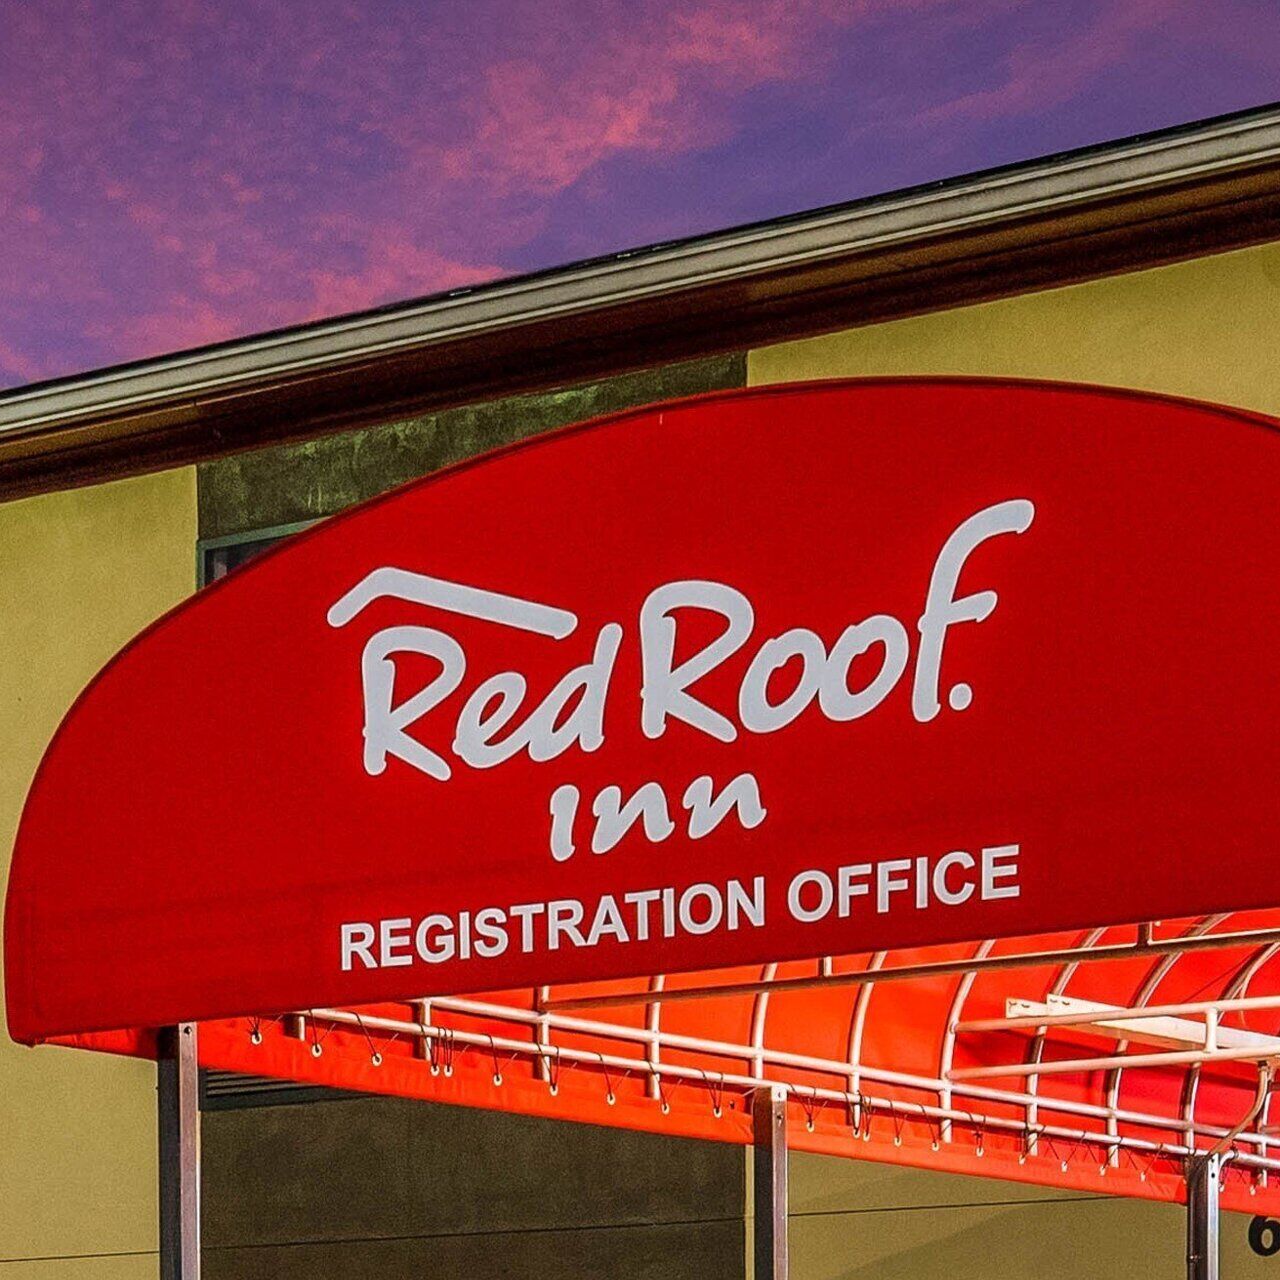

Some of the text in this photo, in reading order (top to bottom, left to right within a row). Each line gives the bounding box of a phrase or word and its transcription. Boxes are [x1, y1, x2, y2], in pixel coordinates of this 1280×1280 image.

[361, 621, 623, 782] Red
[339, 844, 1021, 972] REGISTRATION OFFICE
